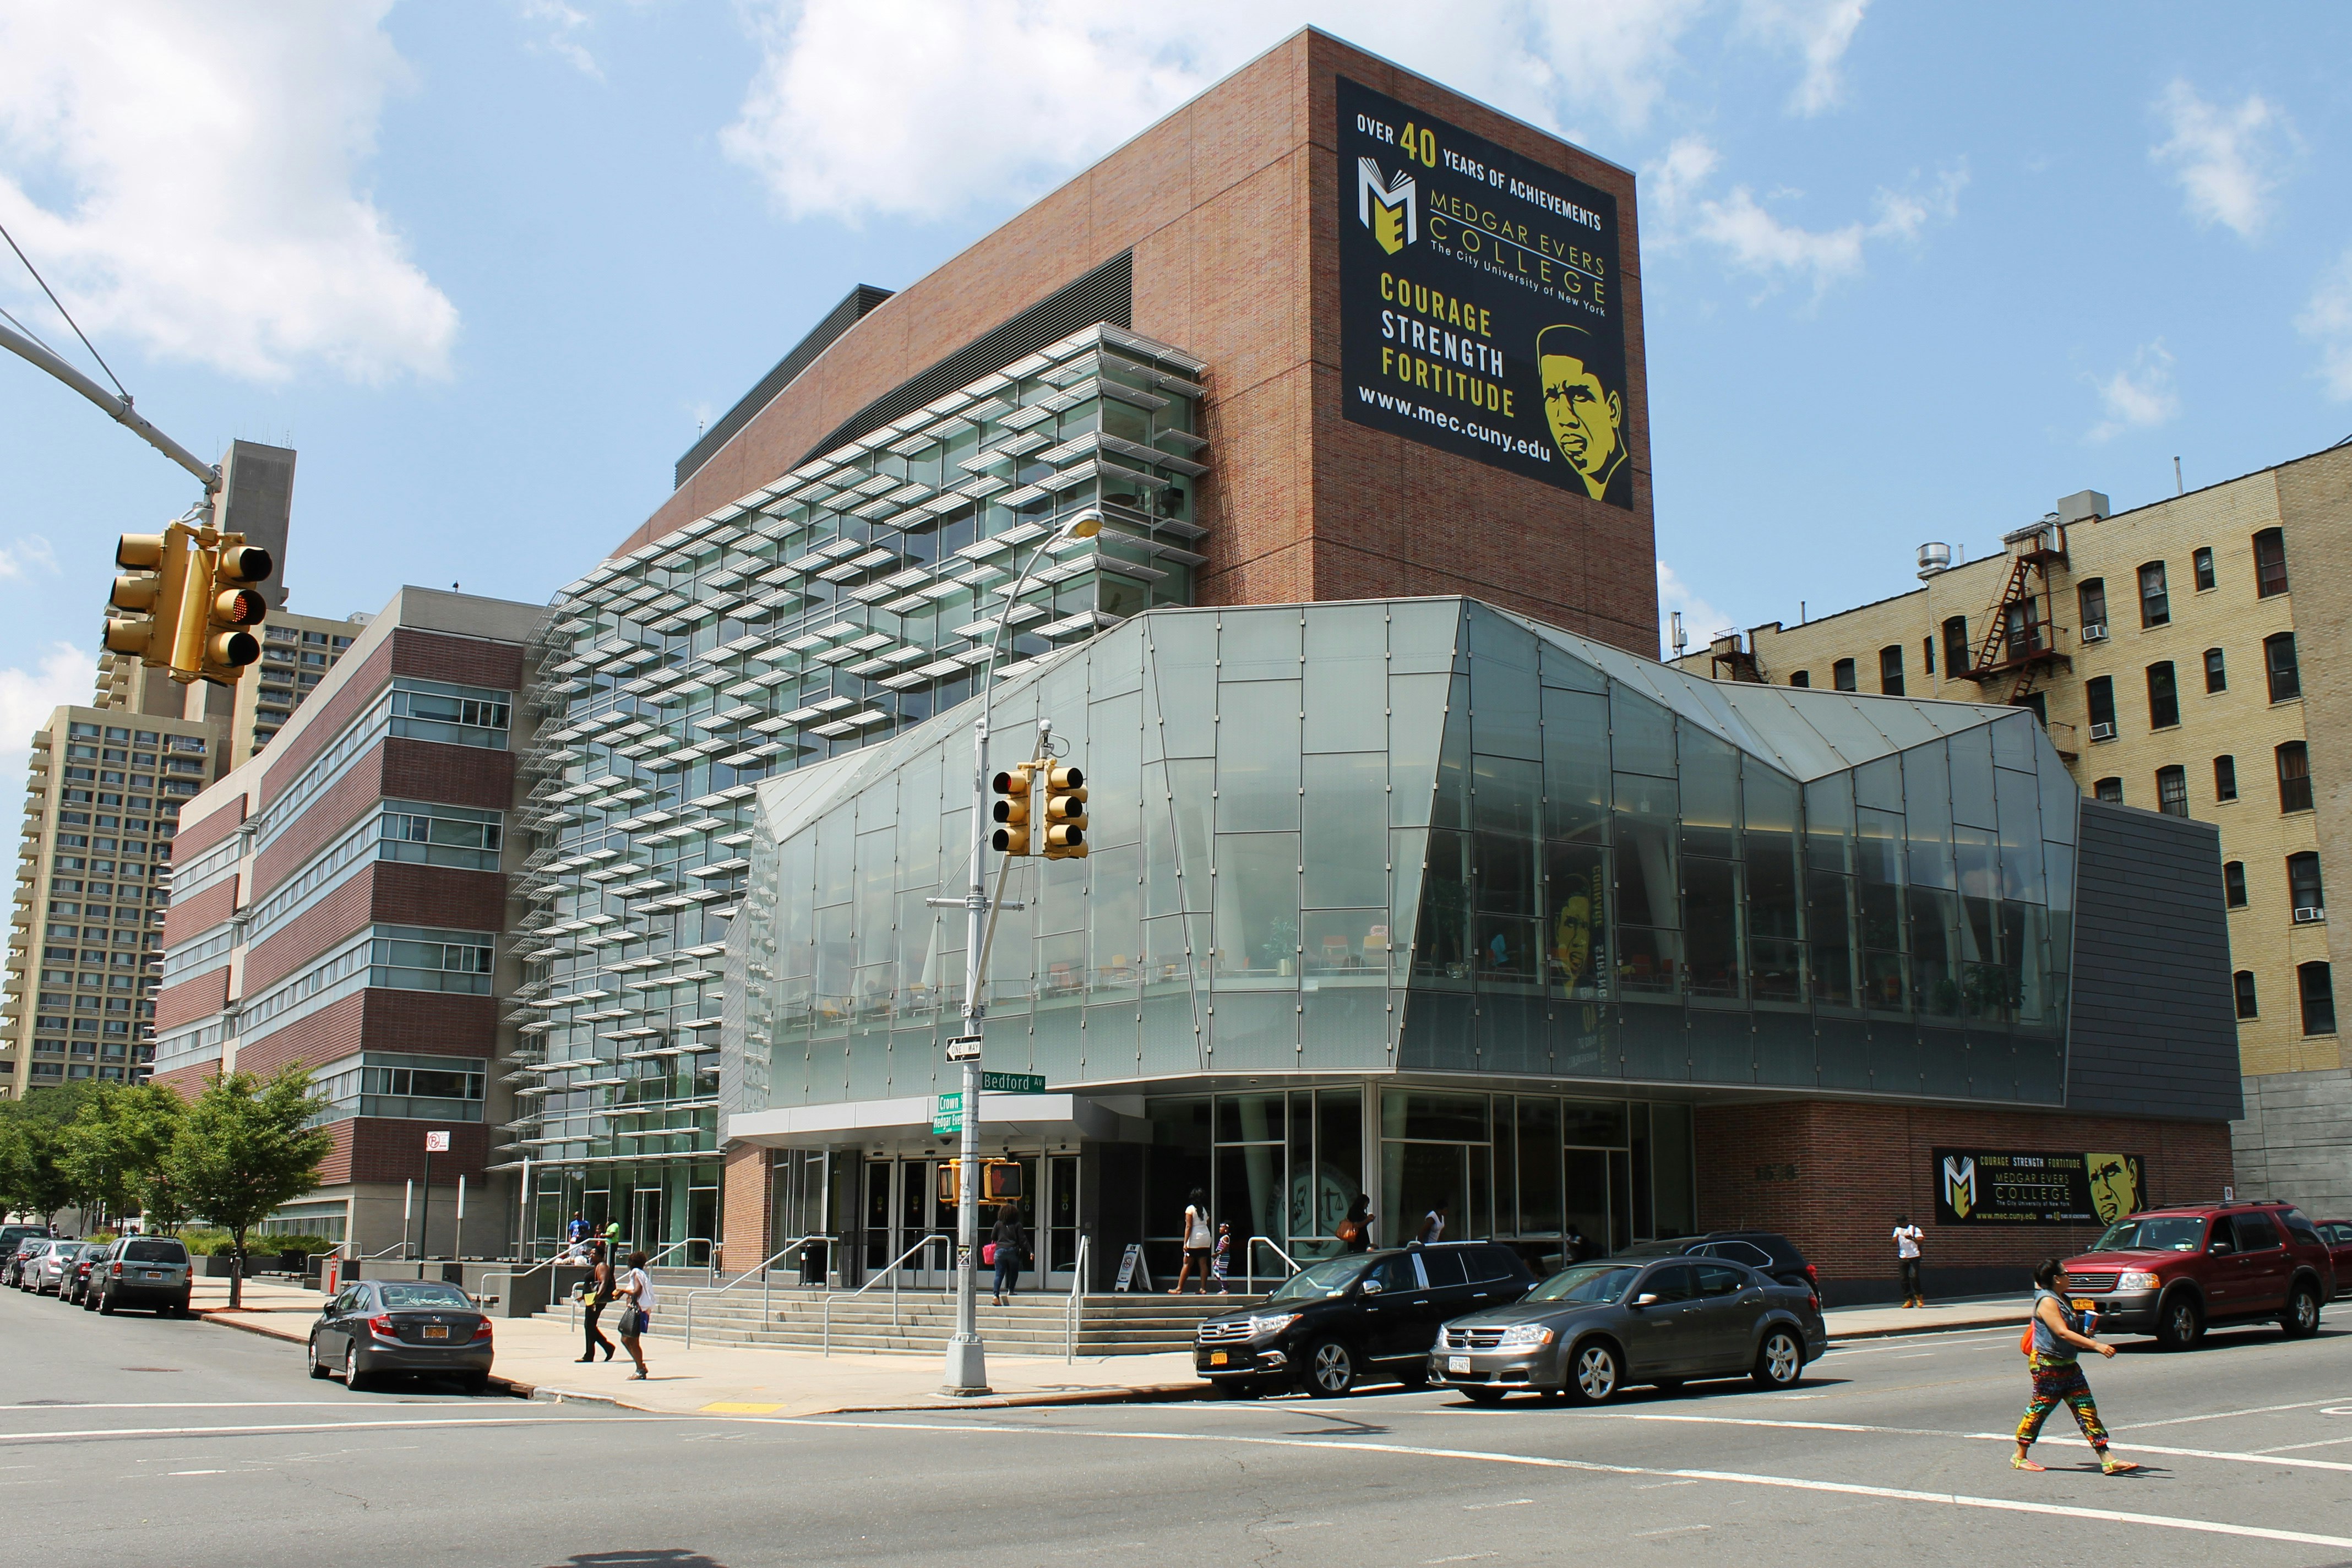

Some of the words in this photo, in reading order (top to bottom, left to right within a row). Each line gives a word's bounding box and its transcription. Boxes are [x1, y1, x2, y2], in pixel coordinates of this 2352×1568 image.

[1357, 113, 1393, 144] OVER
[1400, 122, 1436, 168] 40
[1443, 148, 1484, 182] YEARS
[1489, 168, 1505, 189] OF
[1510, 177, 1602, 231] ACHIEVEMENTS
[1431, 189, 1528, 244] MEDGAR
[1540, 234, 1604, 275] EVERS
[1430, 216, 1604, 304] COLLEGE
[1431, 239, 1451, 256] The
[1457, 251, 1479, 268] City
[1484, 260, 1539, 292] University
[1544, 286, 1554, 296] of
[1558, 290, 1579, 307] New
[1583, 300, 1605, 317] York
[1381, 272, 1491, 337] COURAGE
[1381, 310, 1504, 378] STRENGTH
[1382, 347, 1515, 418] FORTITUDE
[1358, 385, 1551, 462] www.mec.cuny.edu
[951, 1044, 962, 1054] ONE
[968, 1043, 979, 1053] WAY
[984, 1074, 1029, 1090] Bedford
[1034, 1077, 1042, 1086] Av
[934, 1114, 951, 1130] Medgar
[952, 1114, 962, 1126] Ever
[940, 1096, 959, 1110] Crown
[1980, 1156, 2009, 1166] COURAGE
[2013, 1157, 2044, 1167] STRENGTH
[2048, 1158, 2081, 1168] FORTITUDE
[1995, 1173, 2037, 1183] MEDGAR
[2040, 1174, 2069, 1184] EVERS
[1995, 1186, 2070, 1200] COLLEGE
[1975, 1212, 2037, 1221] www.mec.cuny.edu
